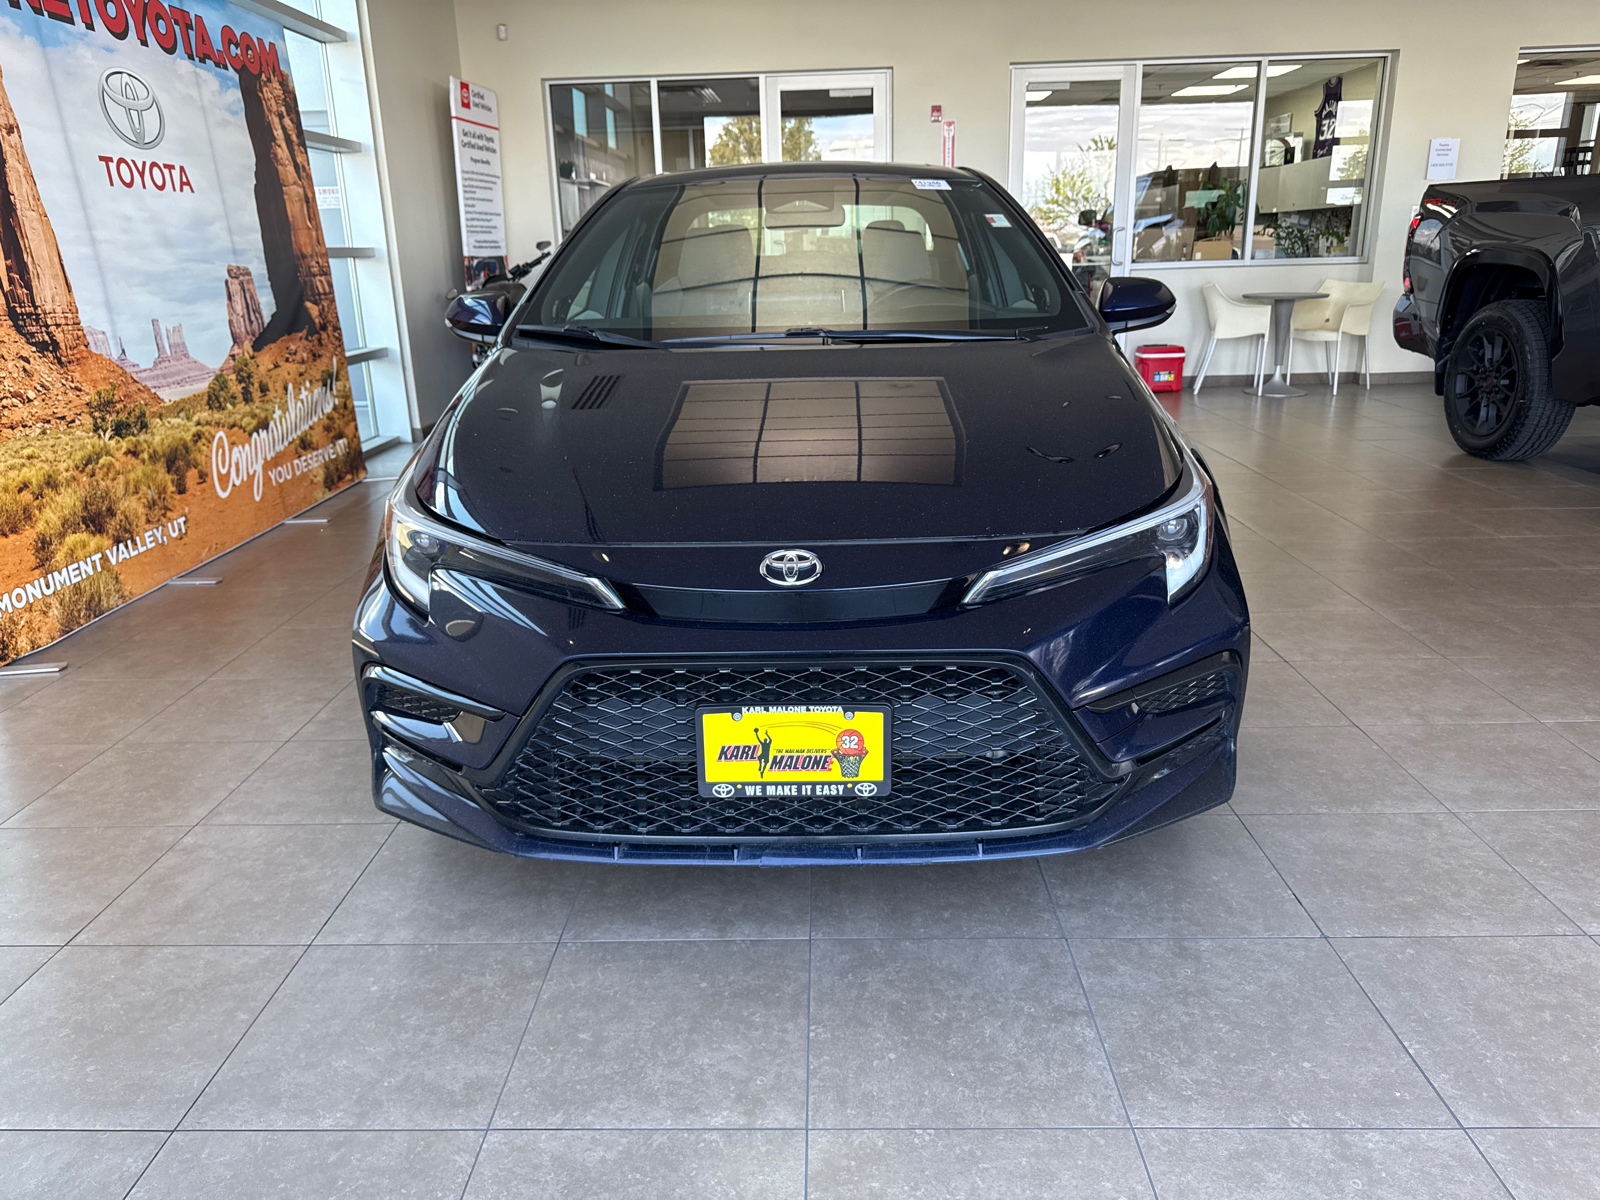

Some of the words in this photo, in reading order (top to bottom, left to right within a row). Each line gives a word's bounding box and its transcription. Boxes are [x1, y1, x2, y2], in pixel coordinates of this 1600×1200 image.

[7, 0, 282, 82] OYOTA.COM
[1318, 118, 1337, 141] 32
[98, 155, 195, 193] TOYOTA
[212, 354, 339, 502] Congratulations!
[268, 462, 292, 486] YOU
[293, 443, 337, 476] DESERVE
[335, 437, 349, 456] IT!
[0, 552, 103, 618] MONUMENT
[105, 526, 168, 566] VALLEY,
[167, 516, 187, 539] UT
[742, 706, 765, 714] KARL
[808, 705, 844, 713] TOYOTA
[717, 744, 760, 762] KARL
[841, 735, 859, 749] 32
[768, 754, 834, 772] MALONE
[745, 785, 763, 796] WE
[766, 785, 798, 796] MAKE
[801, 785, 813, 796] IT
[815, 784, 844, 796] EASY
